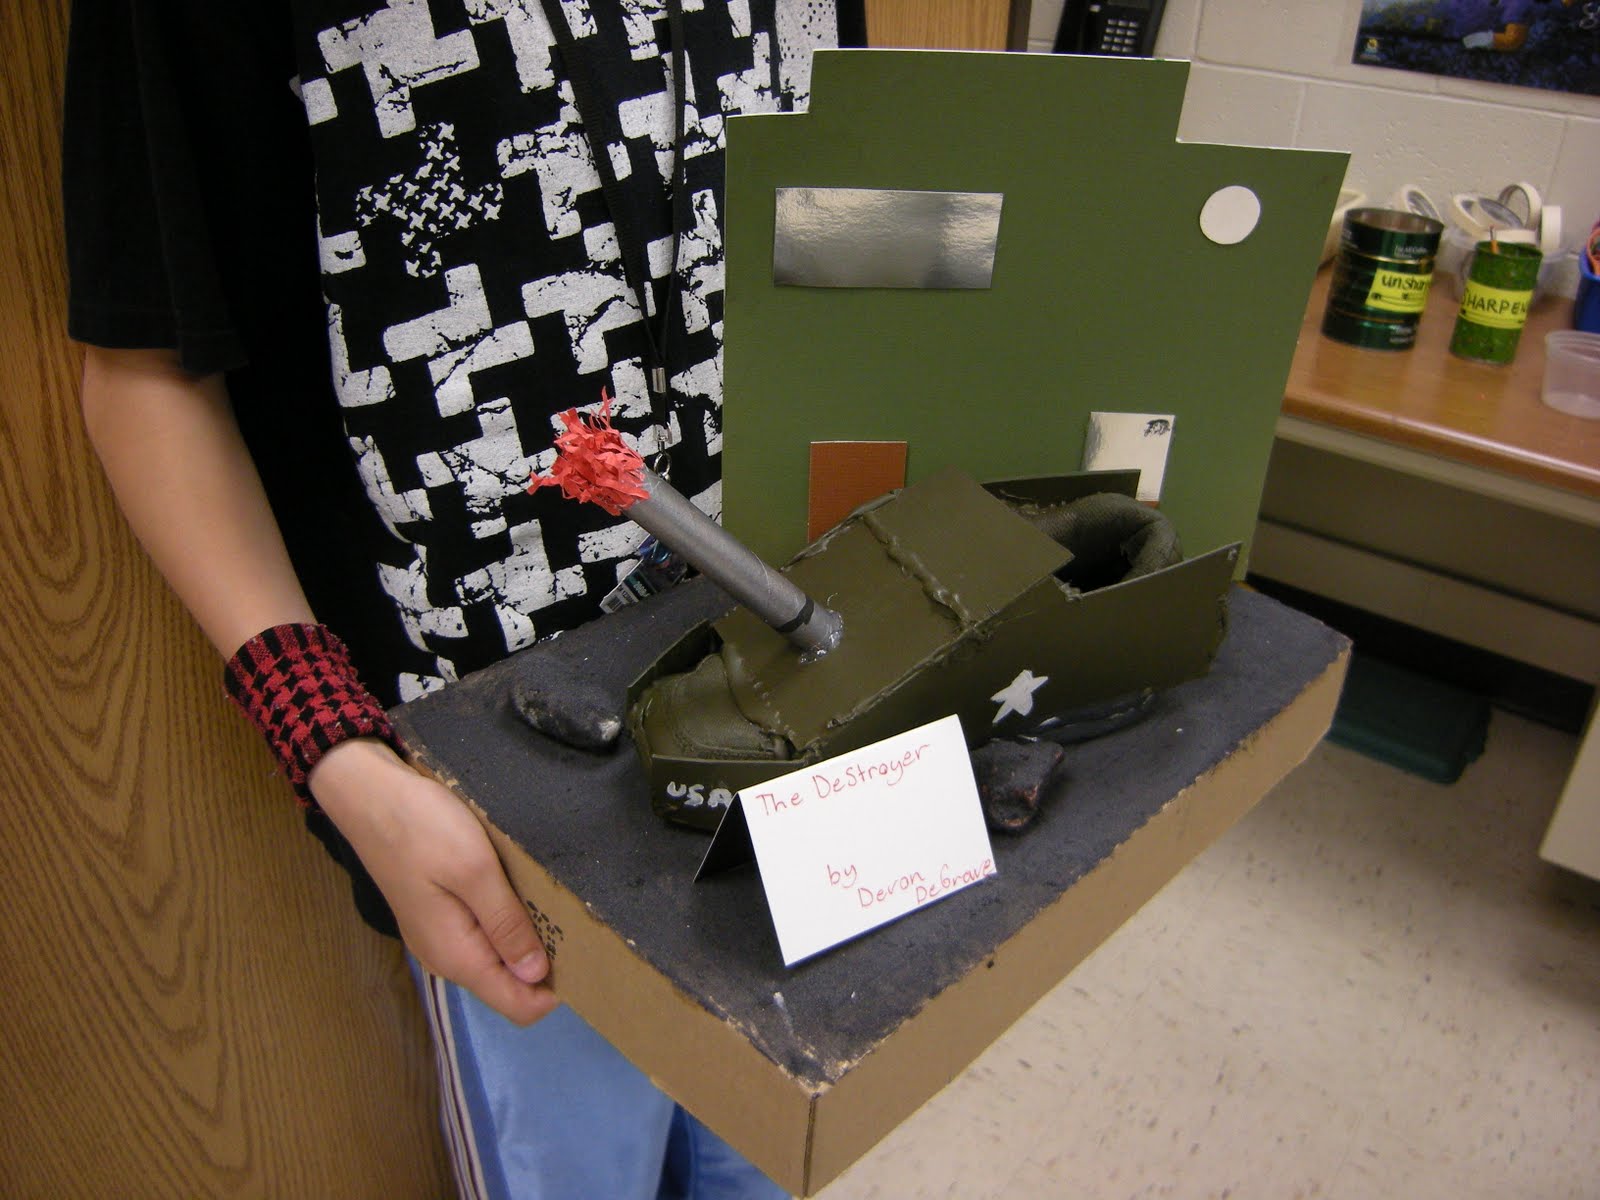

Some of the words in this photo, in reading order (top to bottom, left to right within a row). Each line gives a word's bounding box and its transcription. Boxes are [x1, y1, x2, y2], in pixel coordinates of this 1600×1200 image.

[666, 781, 733, 808] USA
[755, 792, 803, 816] The
[826, 863, 858, 889] by
